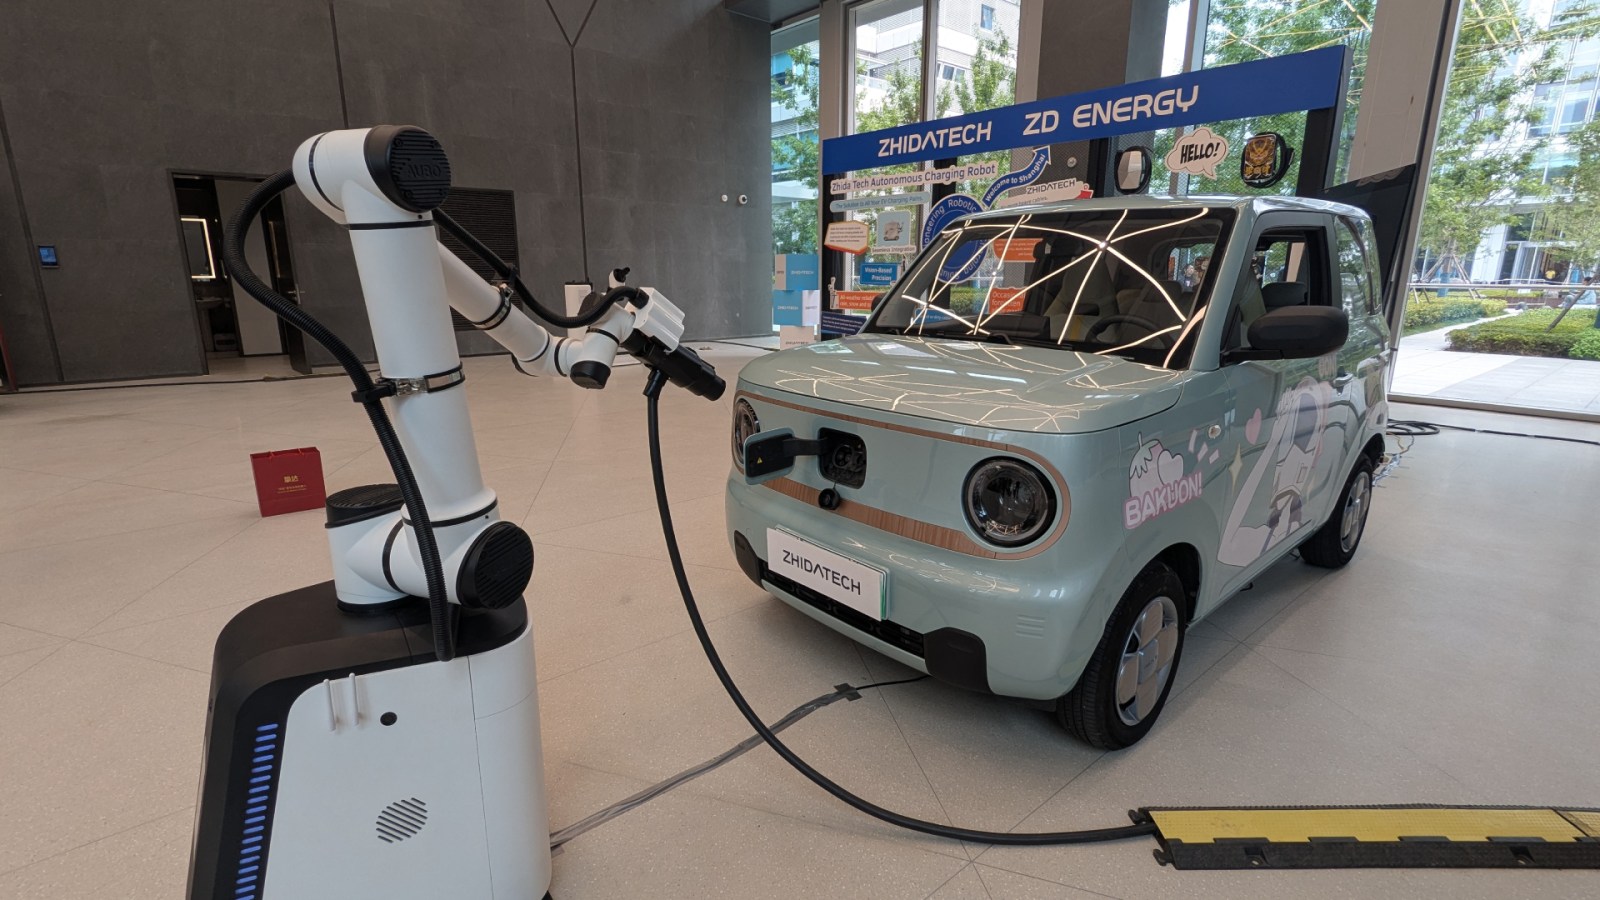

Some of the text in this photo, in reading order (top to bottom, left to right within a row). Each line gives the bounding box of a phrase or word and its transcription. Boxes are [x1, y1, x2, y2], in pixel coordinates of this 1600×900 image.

[877, 84, 1200, 158] ZHIDATECH ZD ENERGY
[1180, 142, 1221, 164] HELLO!
[832, 164, 996, 192] Zhida Tech Autonomous Charging Robot
[985, 153, 1046, 202] Welcome to Shanghai
[1026, 179, 1076, 195] ZHIDATECH
[948, 198, 977, 212] Robotic
[864, 266, 893, 274] Vision-Based
[782, 549, 861, 596] ZHIDATECH
